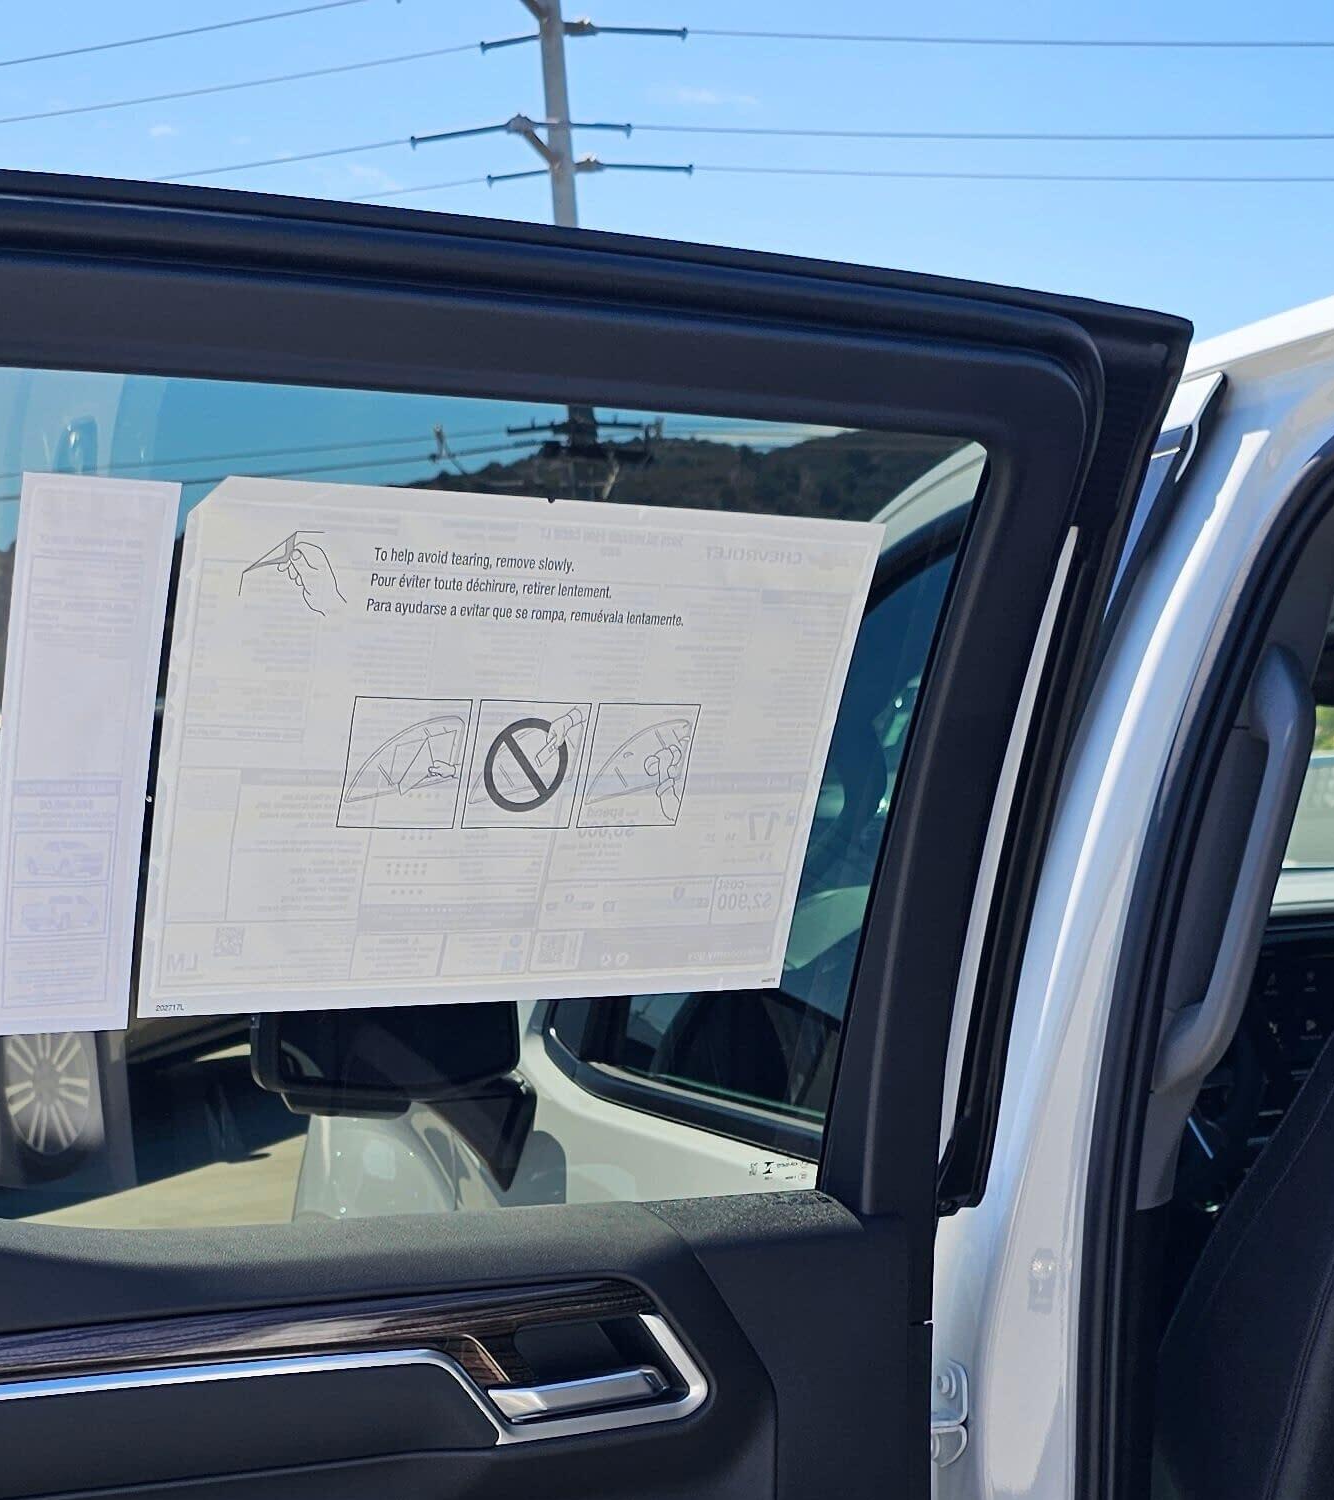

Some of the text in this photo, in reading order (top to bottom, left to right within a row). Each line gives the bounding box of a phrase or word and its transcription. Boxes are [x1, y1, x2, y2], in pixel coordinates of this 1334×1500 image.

[374, 547, 575, 574] To help avoid tearing, remove slowly.
[370, 573, 612, 599] Pour éviter toute déchirure, retirer lentement.
[366, 598, 684, 627] Para ayudarse a evitar que se rompa, remuévala lentamente.
